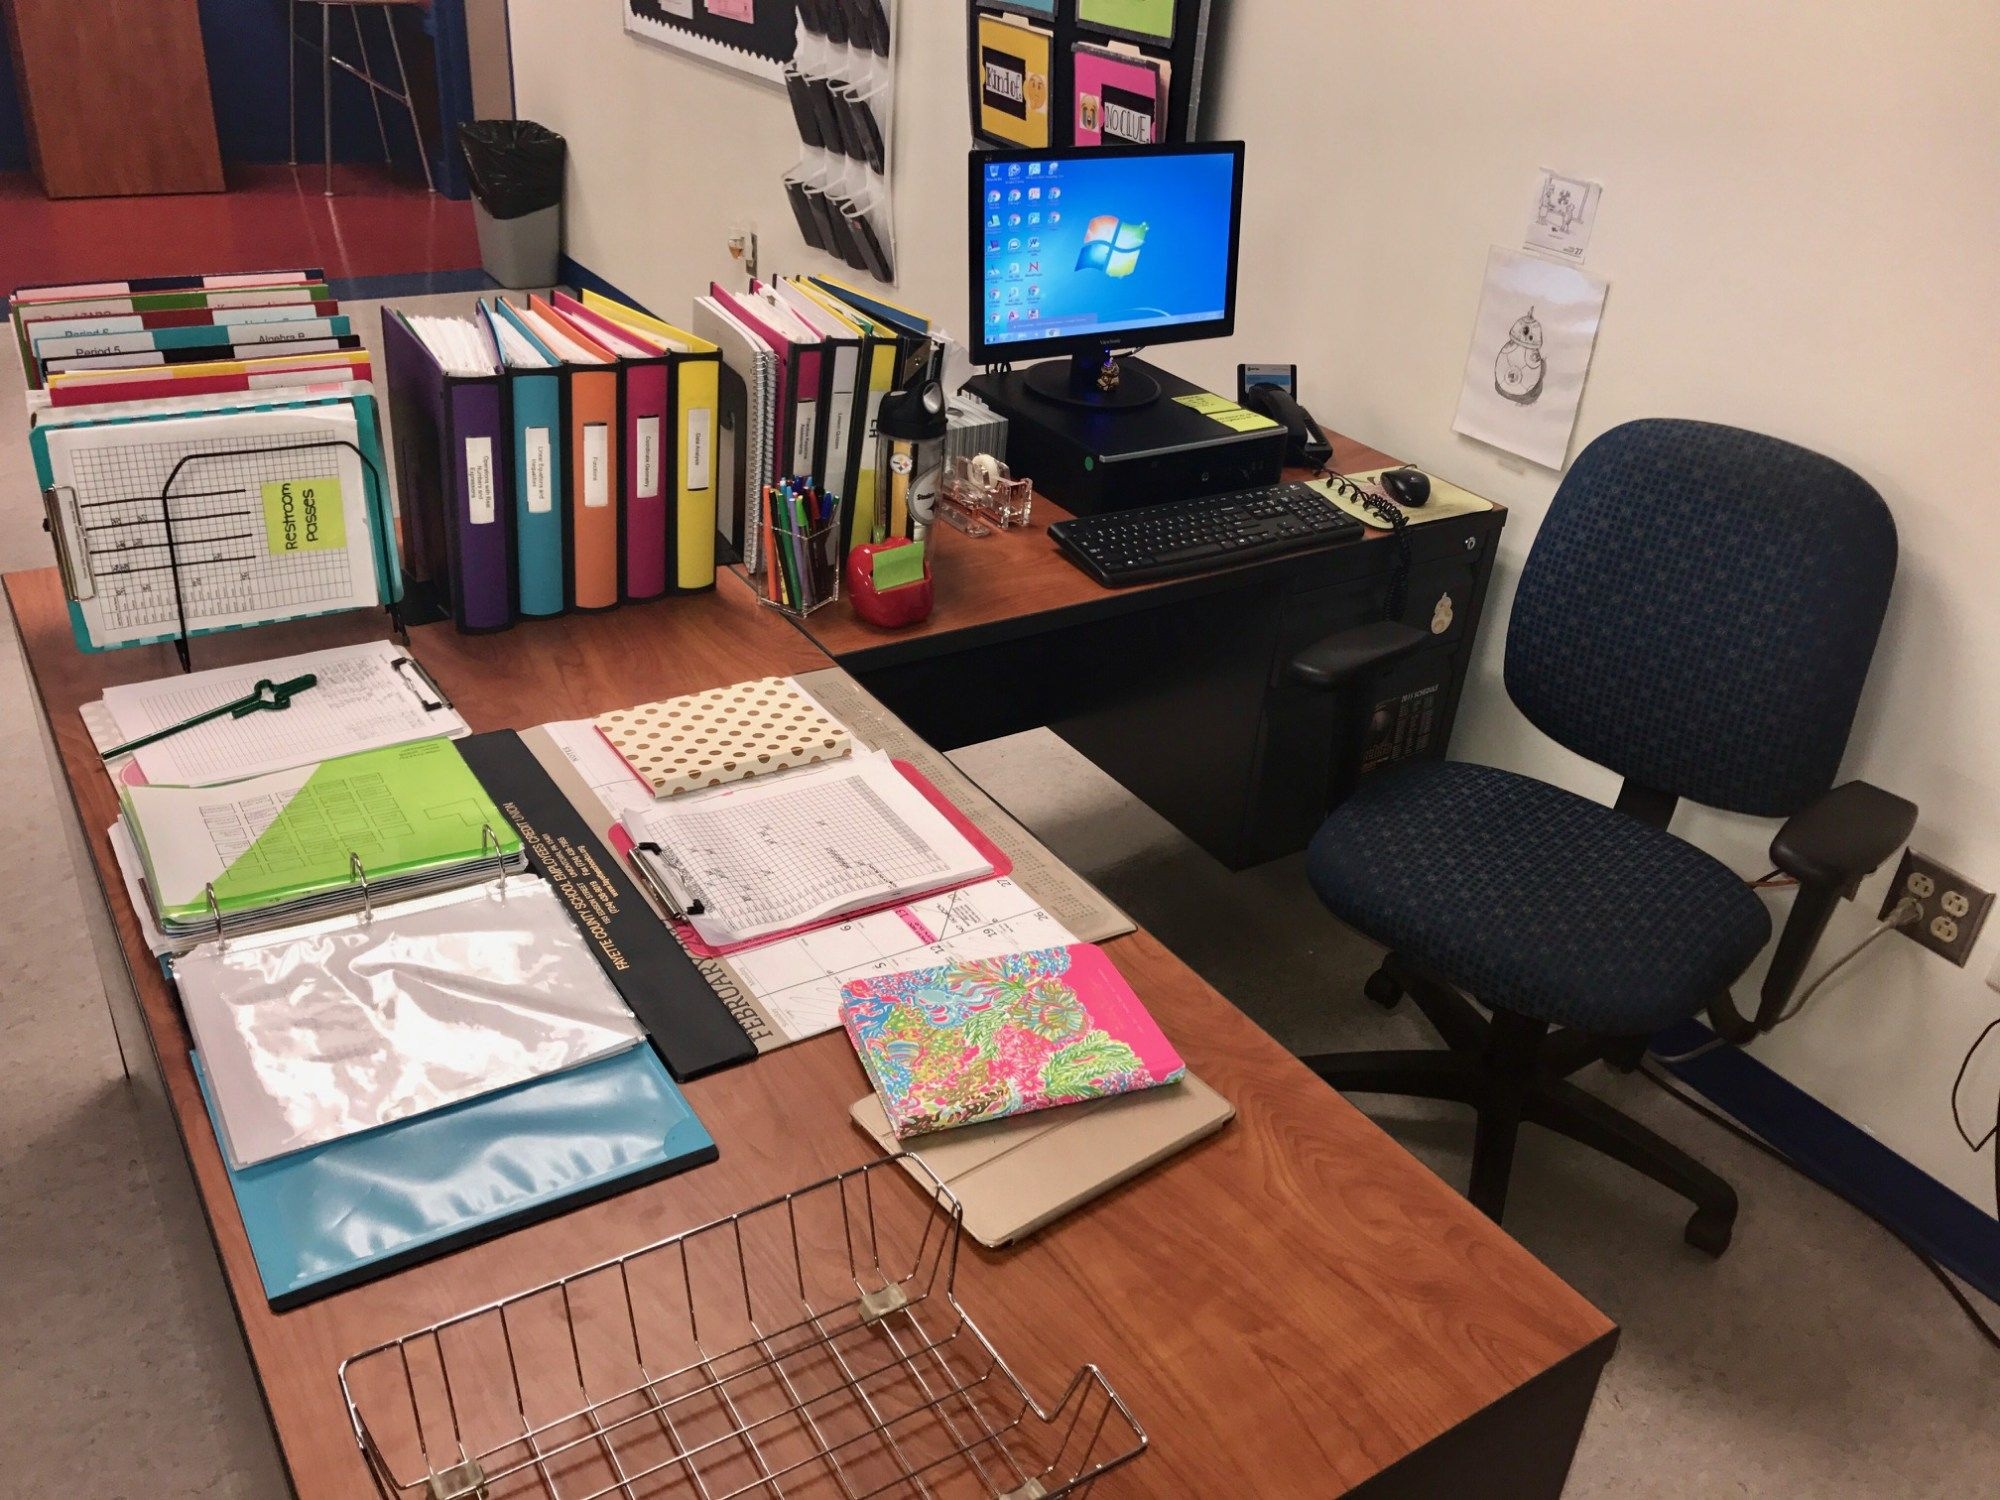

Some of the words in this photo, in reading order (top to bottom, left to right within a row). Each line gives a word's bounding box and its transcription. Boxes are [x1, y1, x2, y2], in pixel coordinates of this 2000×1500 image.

[986, 66, 1009, 95] Kind
[1105, 106, 1119, 131] NO
[76, 345, 112, 356] Period
[476, 465, 484, 489] Numbers
[482, 455, 490, 484] Operations
[643, 463, 651, 488] Geometry
[281, 482, 299, 551] Restroom
[502, 801, 525, 825] UNION
[516, 821, 540, 844] CREDIT
[532, 841, 567, 882] EMPLOYEES
[560, 879, 587, 911] SCHOOL
[576, 882, 594, 900] STREET
[996, 878, 1012, 888] 27
[579, 909, 608, 941] COUNTY
[895, 908, 910, 919] 13
[1034, 910, 1049, 922] 26
[840, 924, 852, 932] 6
[983, 927, 998, 939] 19
[599, 938, 631, 971] FAYETTE
[929, 945, 945, 955] 12
[874, 962, 887, 970] 5
[691, 955, 774, 1042] FEBRUARY
